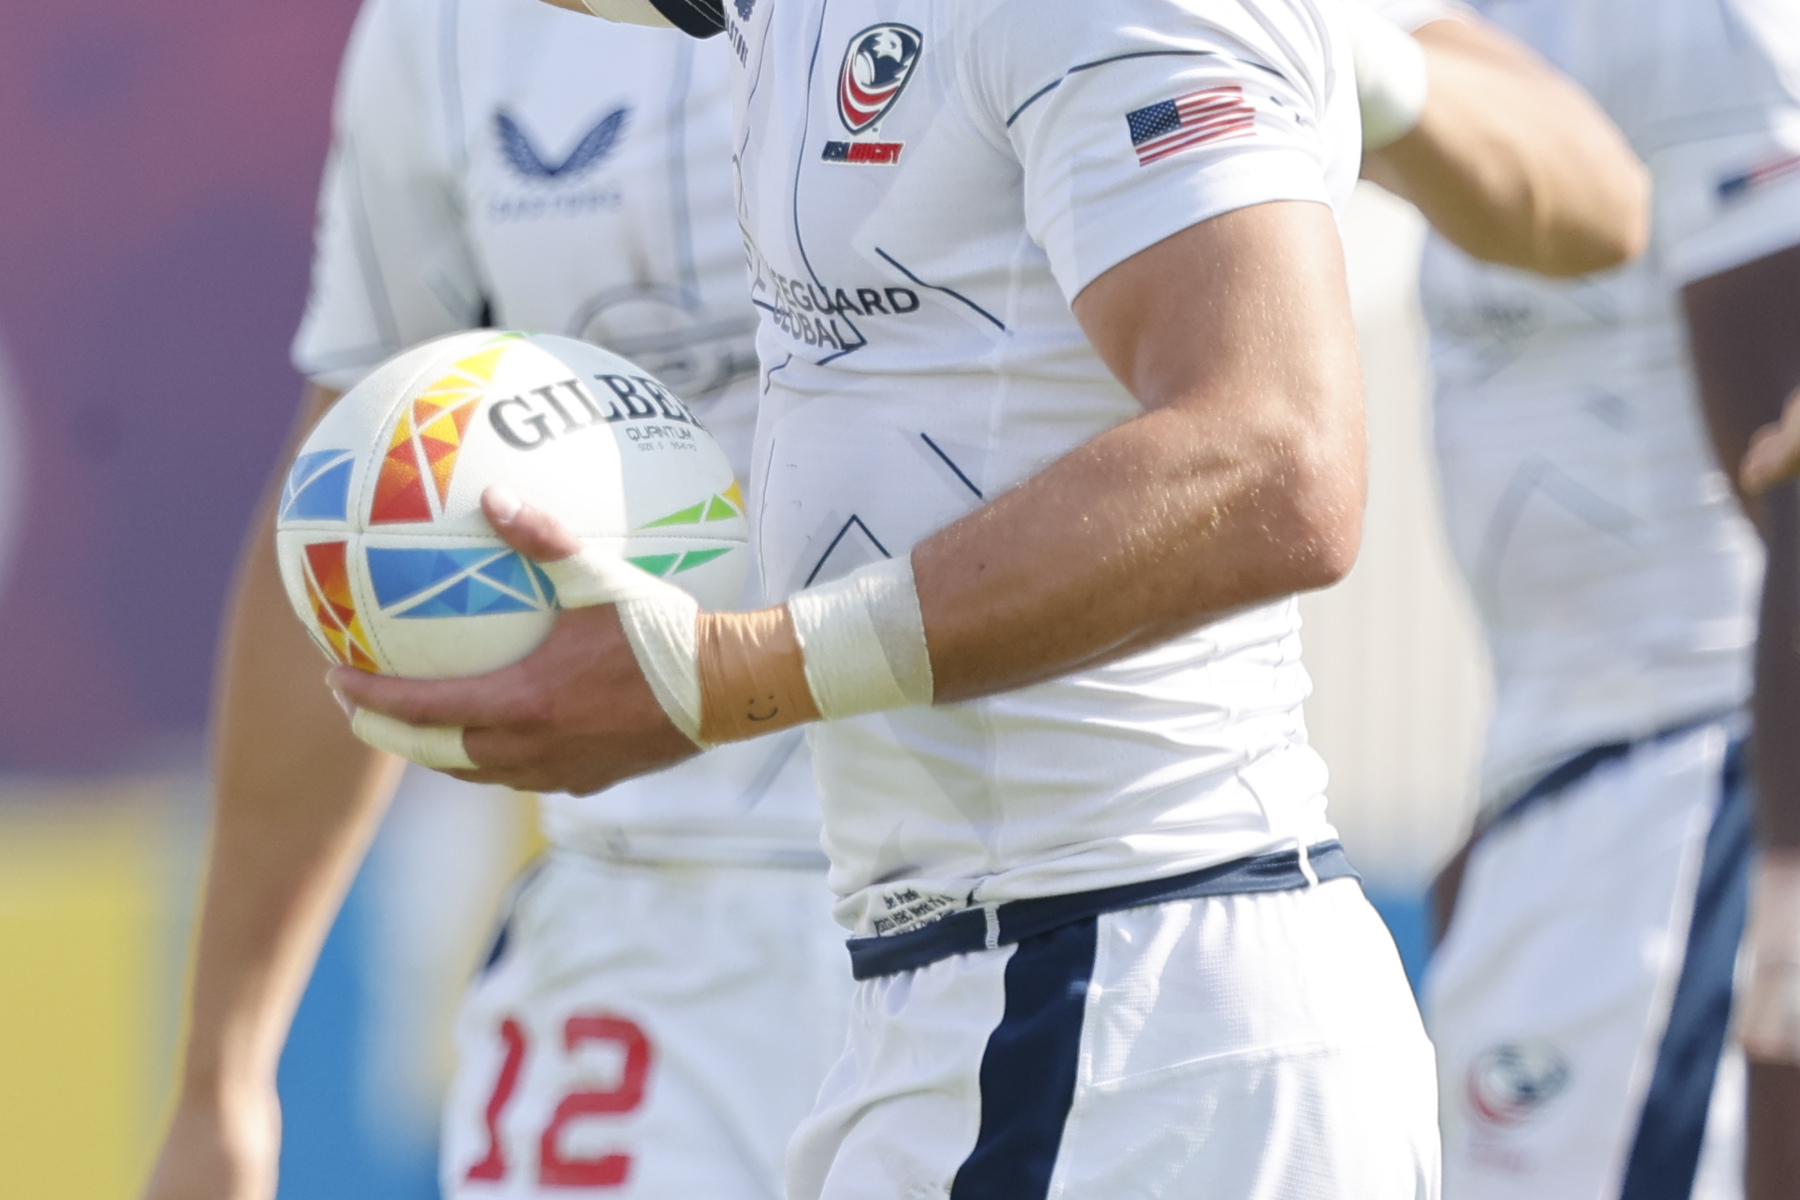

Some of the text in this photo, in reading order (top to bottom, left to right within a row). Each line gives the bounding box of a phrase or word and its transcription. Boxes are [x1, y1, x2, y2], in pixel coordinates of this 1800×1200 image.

[773, 288, 858, 351] GLOBAL
[625, 425, 697, 442] QUANTUM
[462, 1014, 652, 1188] 12
